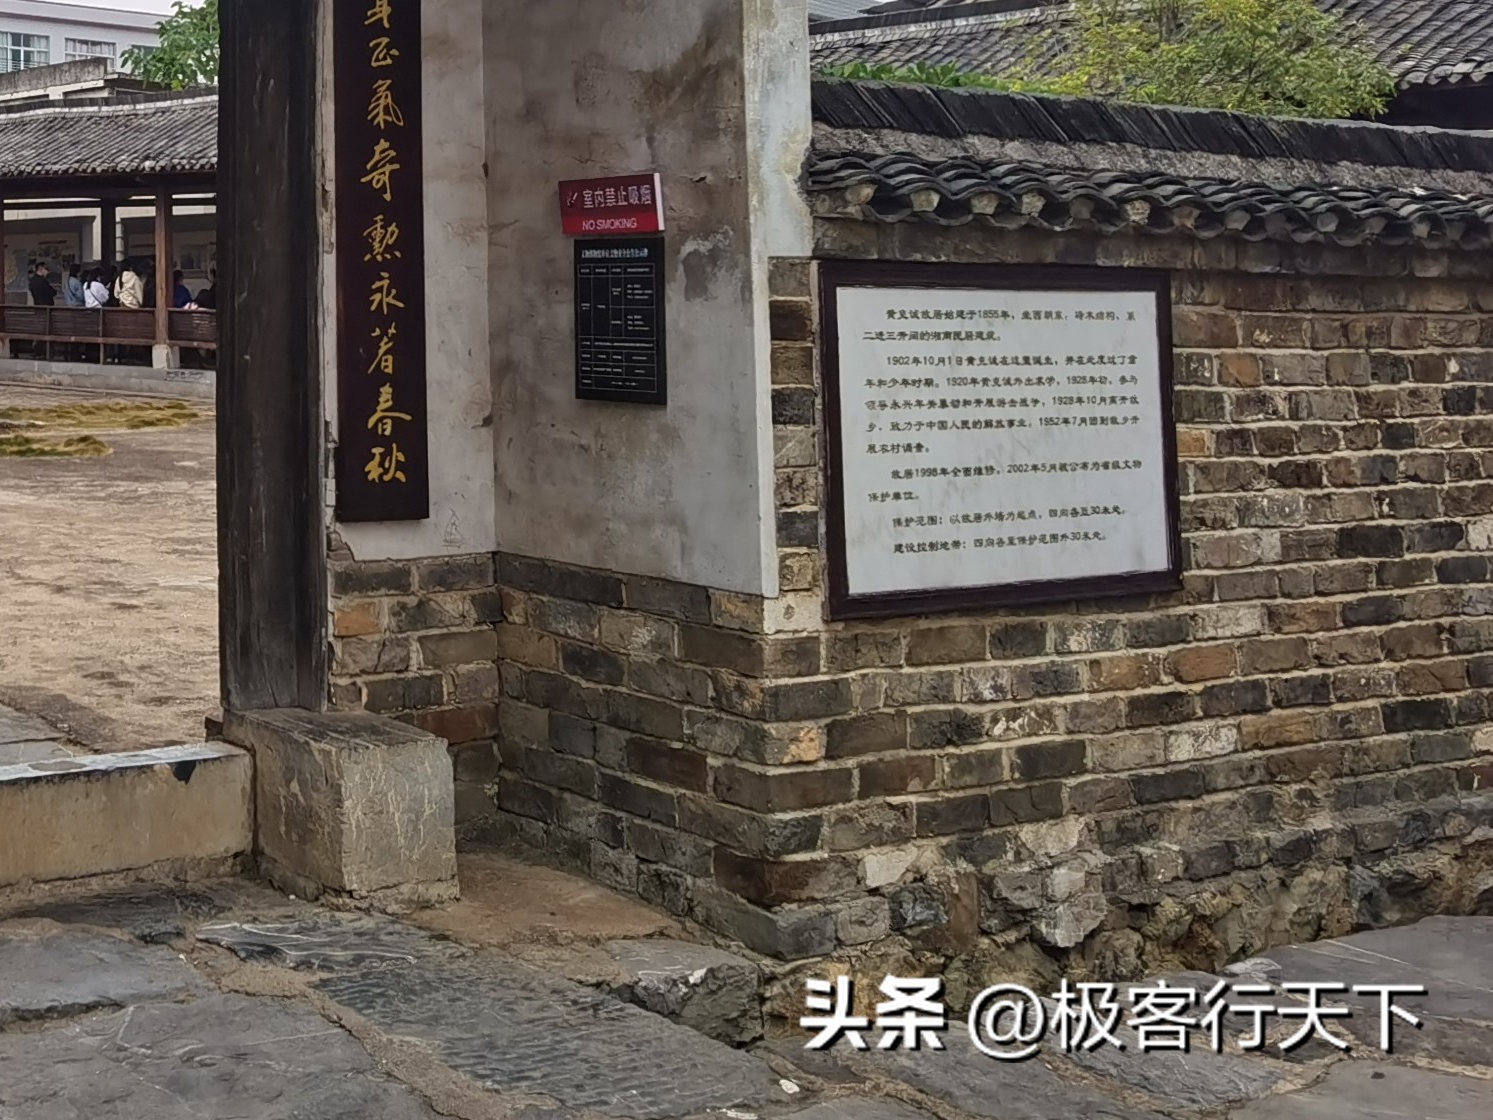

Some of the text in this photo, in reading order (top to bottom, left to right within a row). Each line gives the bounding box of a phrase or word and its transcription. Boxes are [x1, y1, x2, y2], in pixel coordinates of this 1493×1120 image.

[582, 184, 652, 209] 室内禁止吸烟
[582, 217, 637, 230] NO SMOKING
